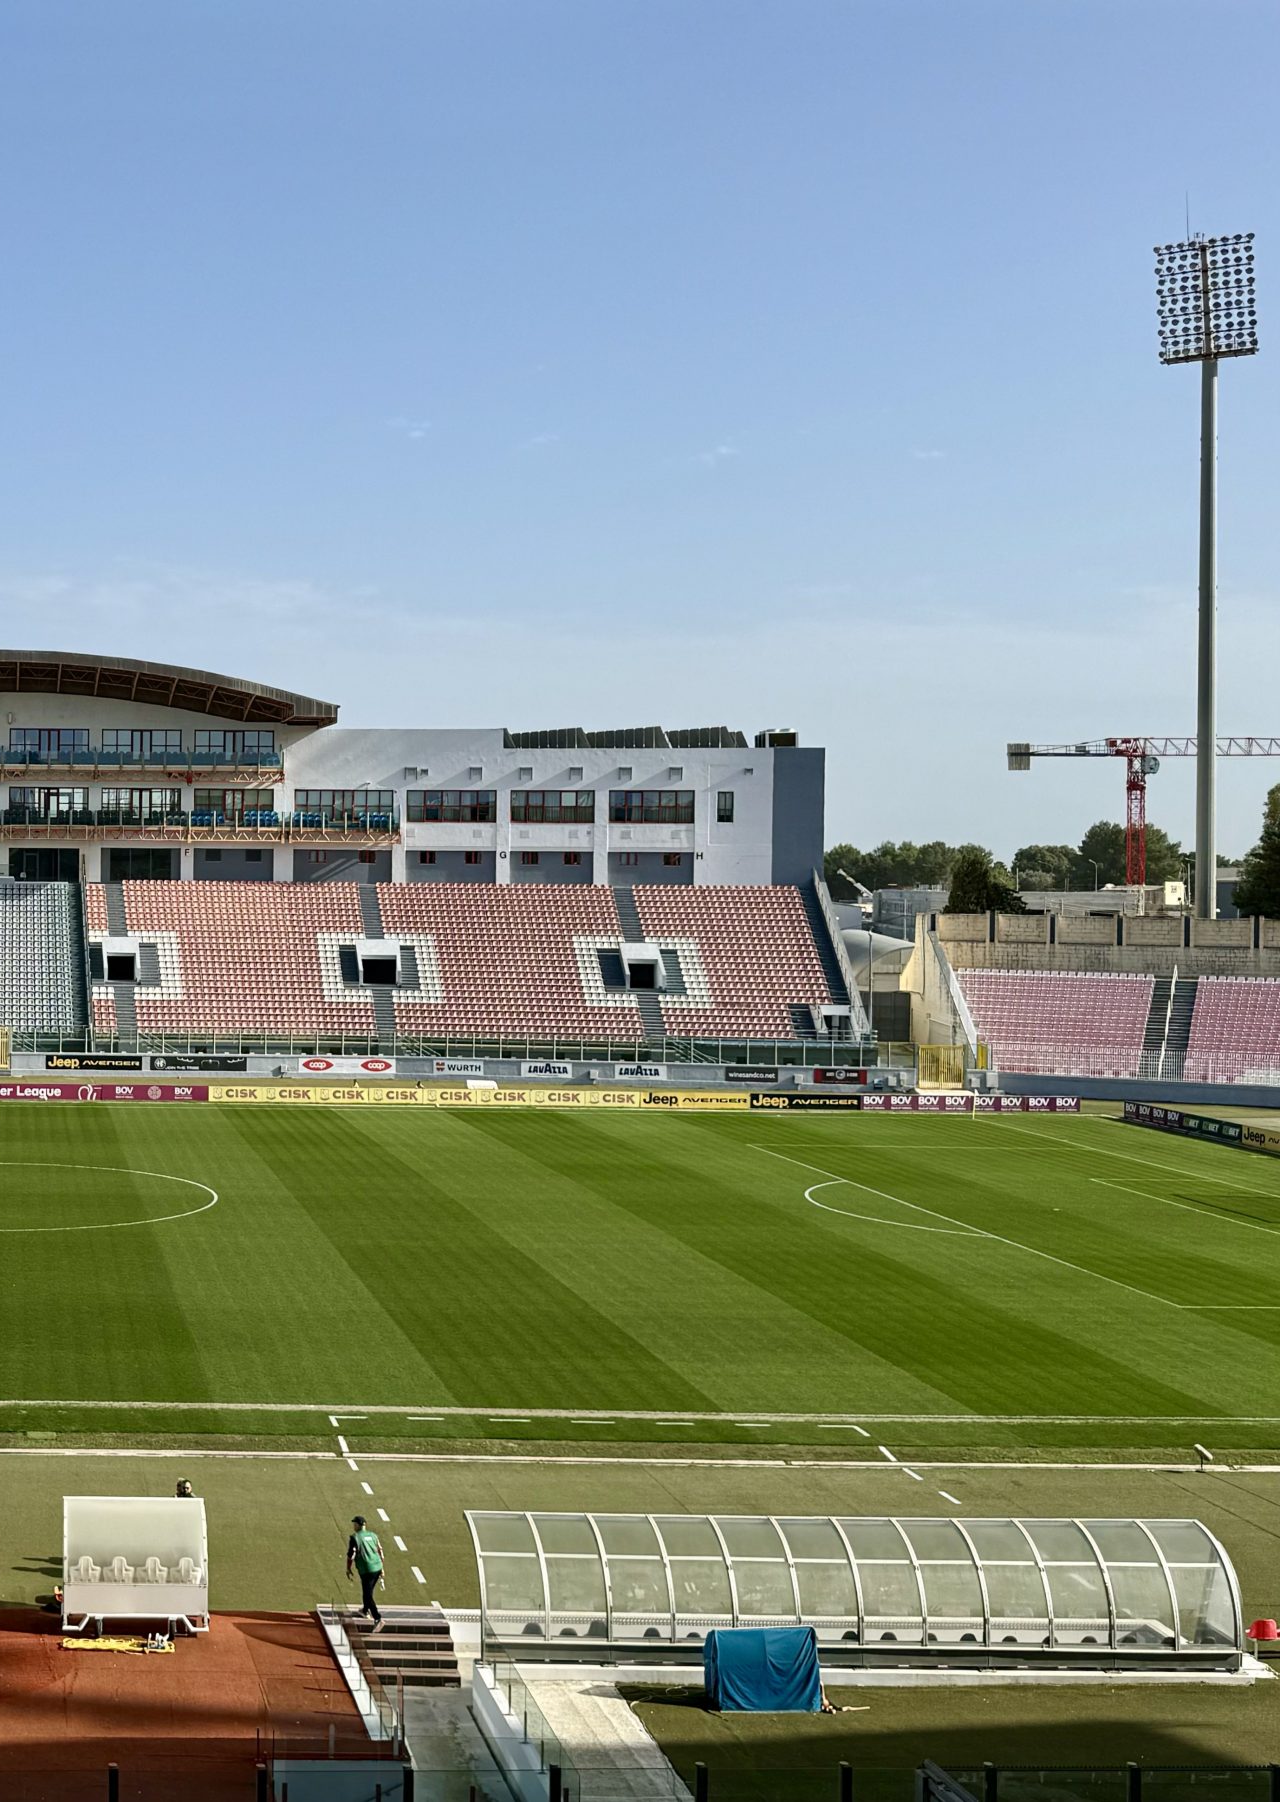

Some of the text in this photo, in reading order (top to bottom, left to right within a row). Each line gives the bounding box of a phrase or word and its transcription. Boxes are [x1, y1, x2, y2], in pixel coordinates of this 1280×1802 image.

[499, 851, 507, 859] G
[696, 852, 703, 860] H
[48, 1056, 80, 1068] Jeep
[528, 1064, 568, 1074] LAVAZZA
[619, 1066, 660, 1076] LAVAZZA
[16, 1086, 62, 1098] League
[116, 1086, 133, 1094] BOV
[174, 1087, 192, 1095] BOV
[226, 1089, 257, 1098] CISK
[279, 1090, 310, 1099] CISK
[332, 1090, 364, 1100] CISK
[386, 1090, 418, 1100] CISK
[440, 1091, 472, 1100] CISK
[494, 1092, 526, 1102] CISK
[548, 1092, 580, 1102] CISK
[602, 1094, 635, 1104] CISK
[644, 1093, 678, 1106] Jeep
[753, 1094, 789, 1108] Jeep
[864, 1096, 884, 1104] BOV
[891, 1096, 912, 1104] BOV
[918, 1096, 939, 1104] BOV
[946, 1096, 966, 1105] BOV
[974, 1097, 994, 1106] BOV
[1001, 1098, 1022, 1106] BOV
[1029, 1098, 1049, 1106] BOV
[1056, 1098, 1077, 1106] BOV
[1126, 1103, 1136, 1112] BOV
[1140, 1106, 1150, 1115] BOV
[1153, 1108, 1164, 1118] BOV
[1168, 1111, 1180, 1121] BOV
[1244, 1127, 1266, 1146] Jeep
